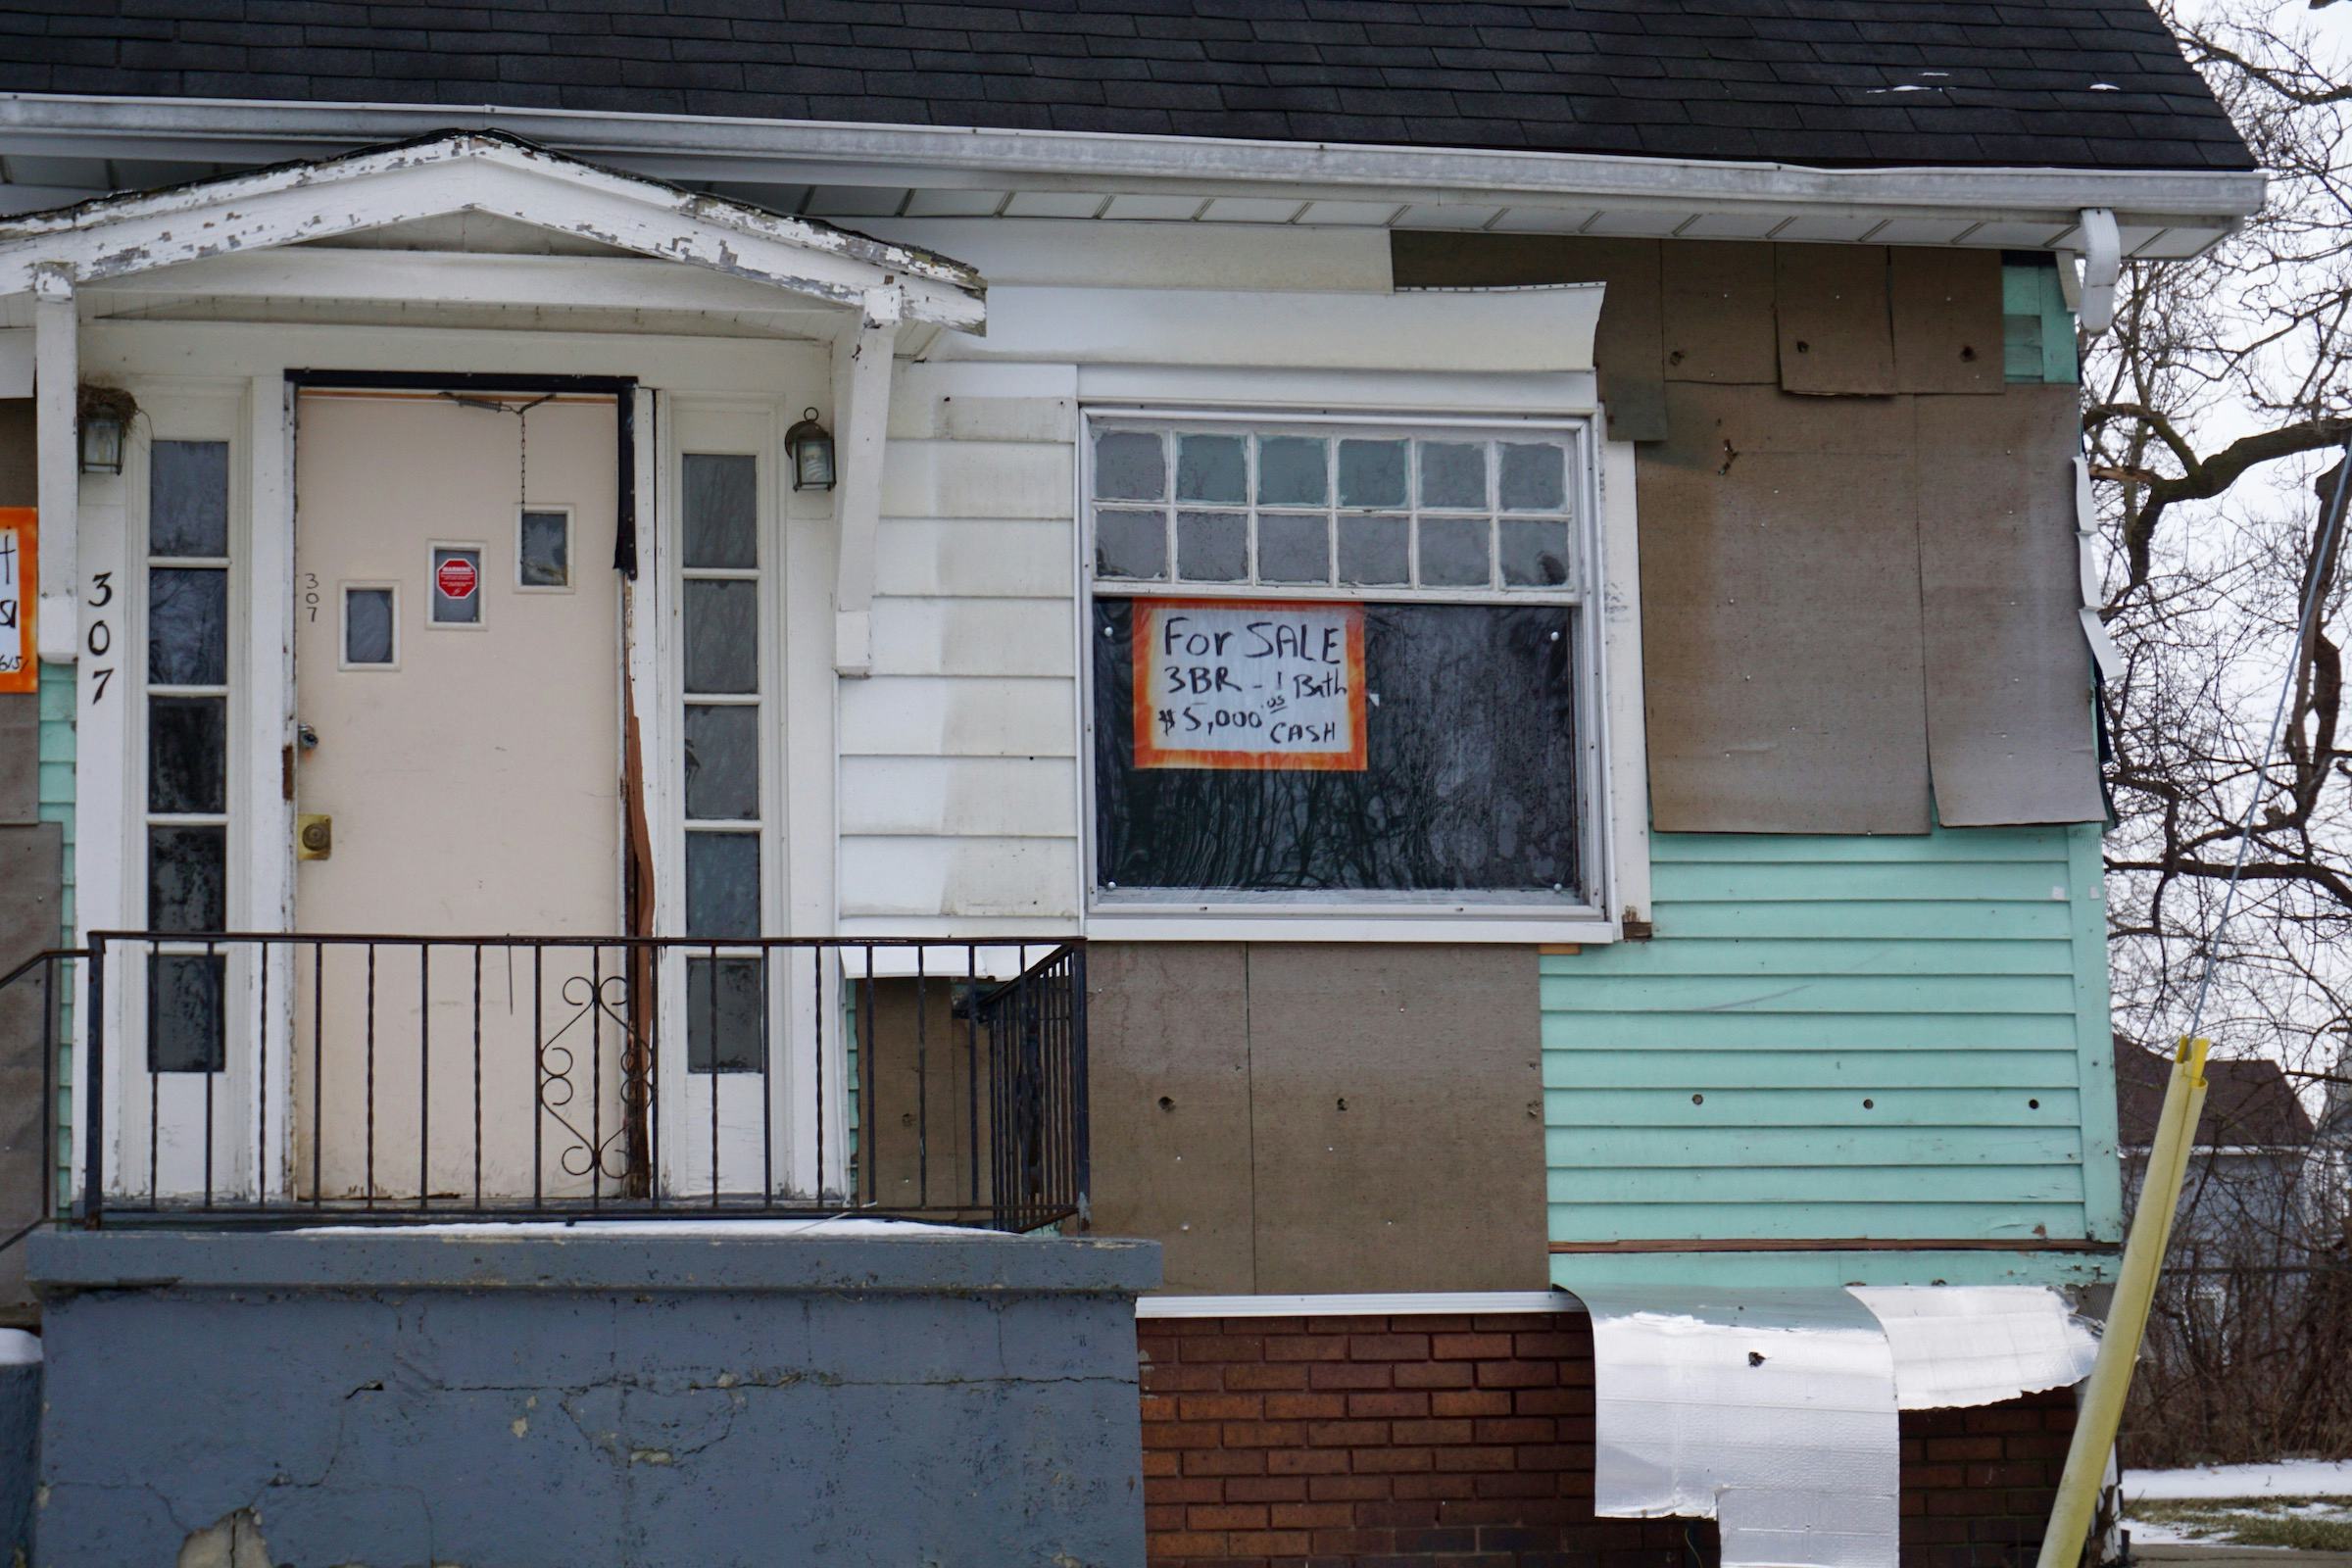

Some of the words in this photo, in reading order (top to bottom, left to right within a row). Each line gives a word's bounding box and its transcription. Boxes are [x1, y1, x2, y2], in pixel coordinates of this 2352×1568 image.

[305, 572, 319, 622] 307
[88, 571, 114, 705] 307
[1164, 616, 1233, 657] For
[1244, 621, 1341, 664] SALE
[1293, 667, 1348, 699] Bath
[1270, 721, 1335, 744] CASH
